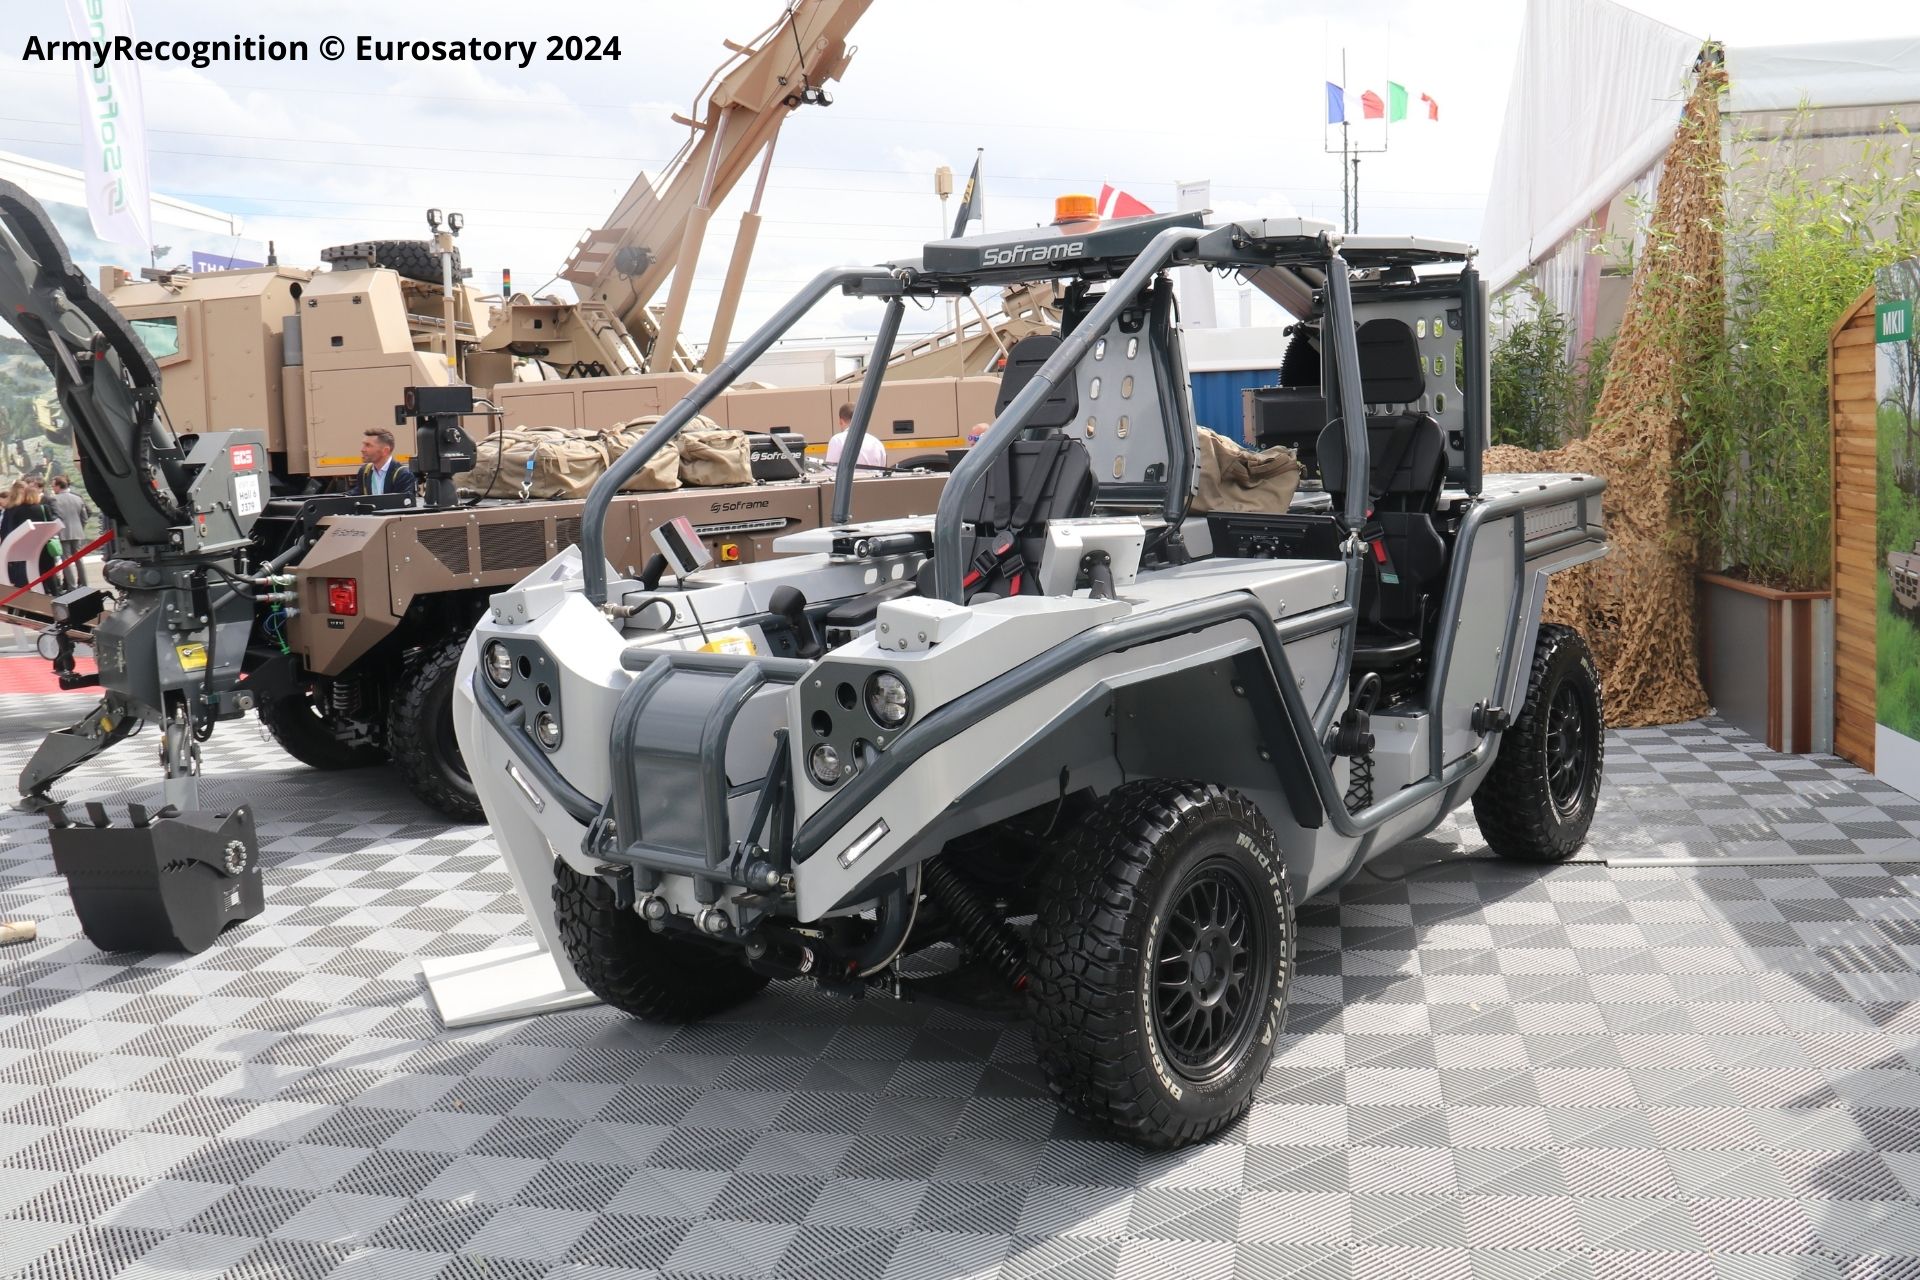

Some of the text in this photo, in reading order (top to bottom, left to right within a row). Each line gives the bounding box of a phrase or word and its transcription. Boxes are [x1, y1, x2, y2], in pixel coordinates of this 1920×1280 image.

[982, 242, 1084, 266] Soframe
[1883, 310, 1904, 336] MKII
[722, 500, 769, 511] Soframe
